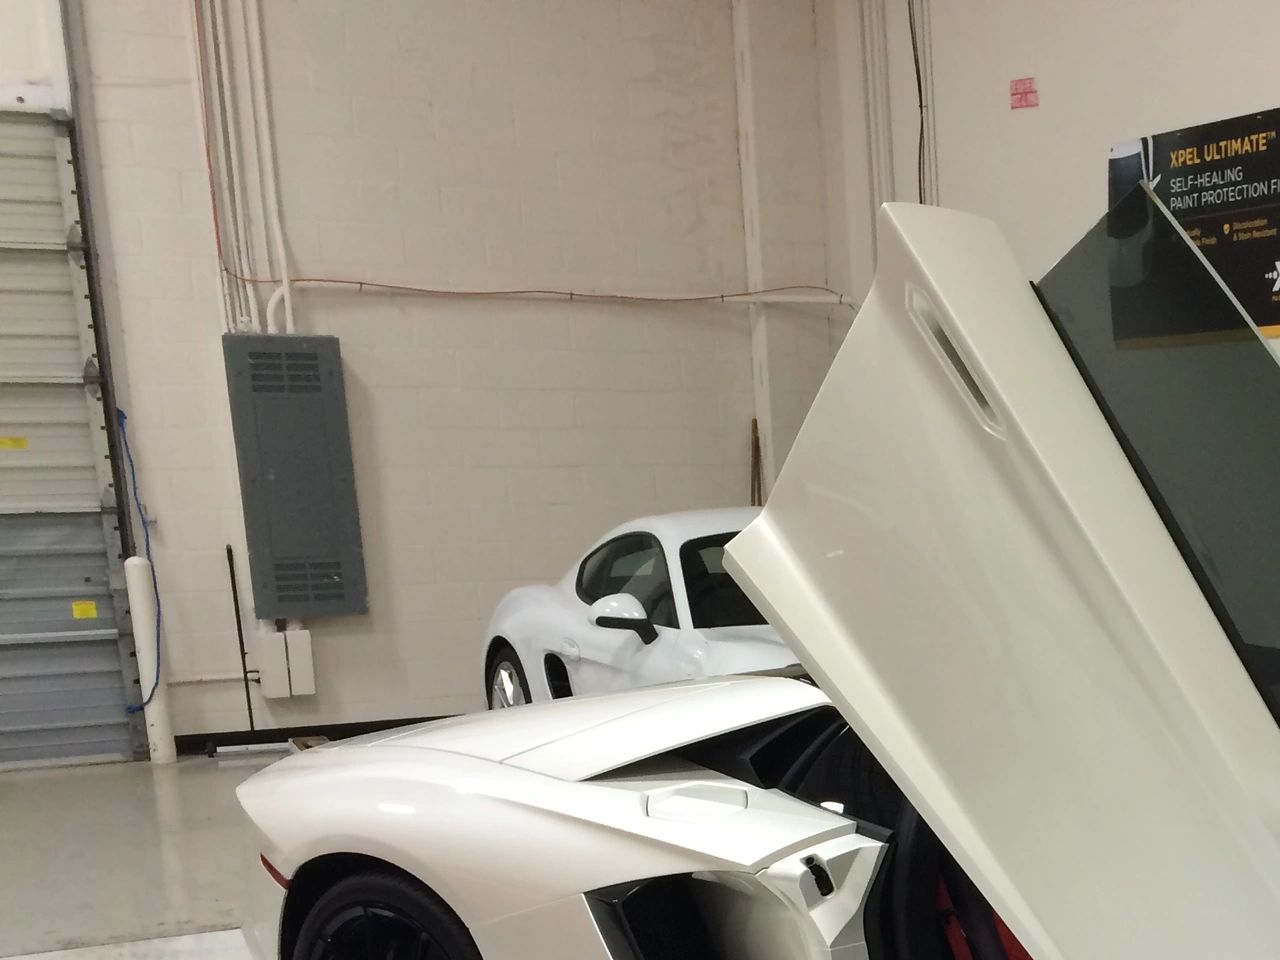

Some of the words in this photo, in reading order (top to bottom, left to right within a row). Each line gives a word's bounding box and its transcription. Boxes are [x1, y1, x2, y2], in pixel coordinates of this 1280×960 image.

[1170, 147, 1201, 168] XPEL
[1170, 166, 1244, 193] SELF-HEALING
[1170, 193, 1199, 211] PAINT
[1201, 181, 1268, 206] PROTECTION
